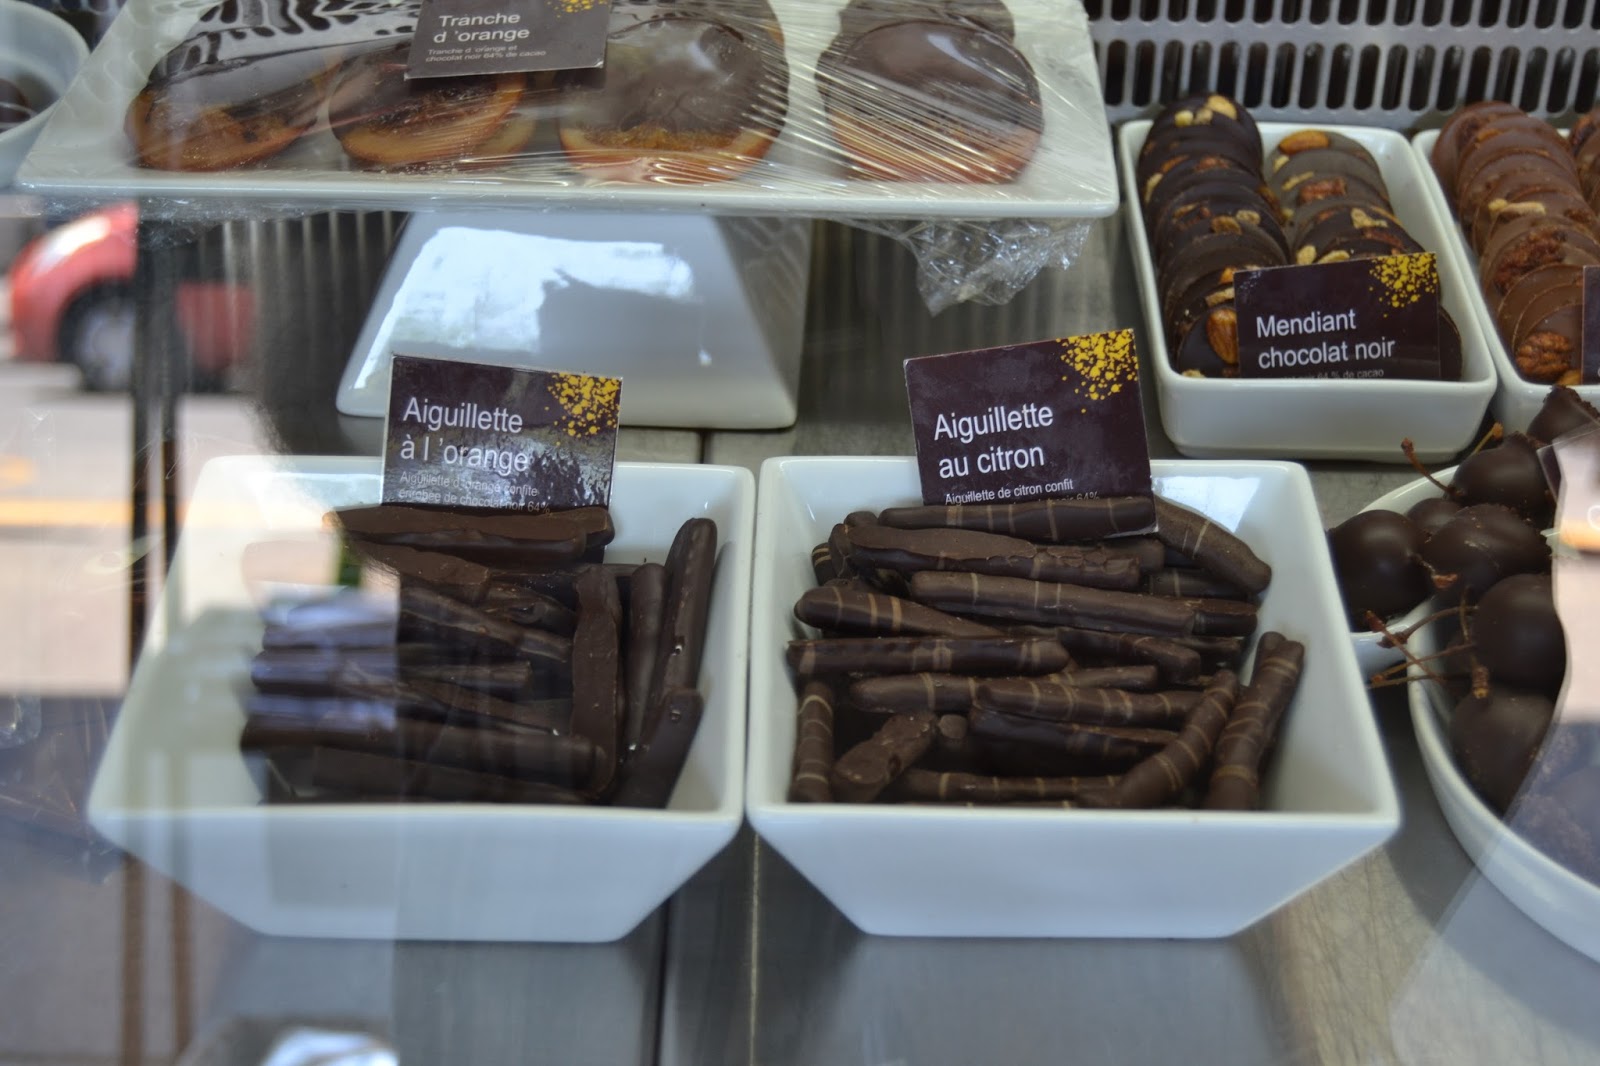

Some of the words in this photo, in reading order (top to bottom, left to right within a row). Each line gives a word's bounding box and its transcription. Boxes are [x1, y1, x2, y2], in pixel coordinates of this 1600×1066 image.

[438, 12, 521, 28] Tranche
[425, 54, 463, 62] chocolat
[464, 53, 481, 61] noir
[519, 50, 547, 58] cacao
[427, 48, 464, 56] Tranche
[1256, 308, 1357, 338] Mendiant
[1258, 340, 1349, 370] chocolat
[1355, 336, 1396, 361] noir
[1357, 368, 1384, 379] cacao
[402, 396, 523, 434] Aiguillette
[934, 403, 1054, 444] Aiguillette
[400, 434, 415, 460] à
[938, 454, 969, 479] au
[976, 445, 1045, 475] citron
[399, 471, 450, 487] Aiguillette
[503, 484, 538, 497] confite
[945, 489, 995, 506] Aiguillette
[997, 486, 1012, 499] de
[1013, 483, 1043, 497] citron
[1045, 478, 1074, 493] confit
[444, 492, 458, 503] de
[527, 501, 551, 514] 64%
